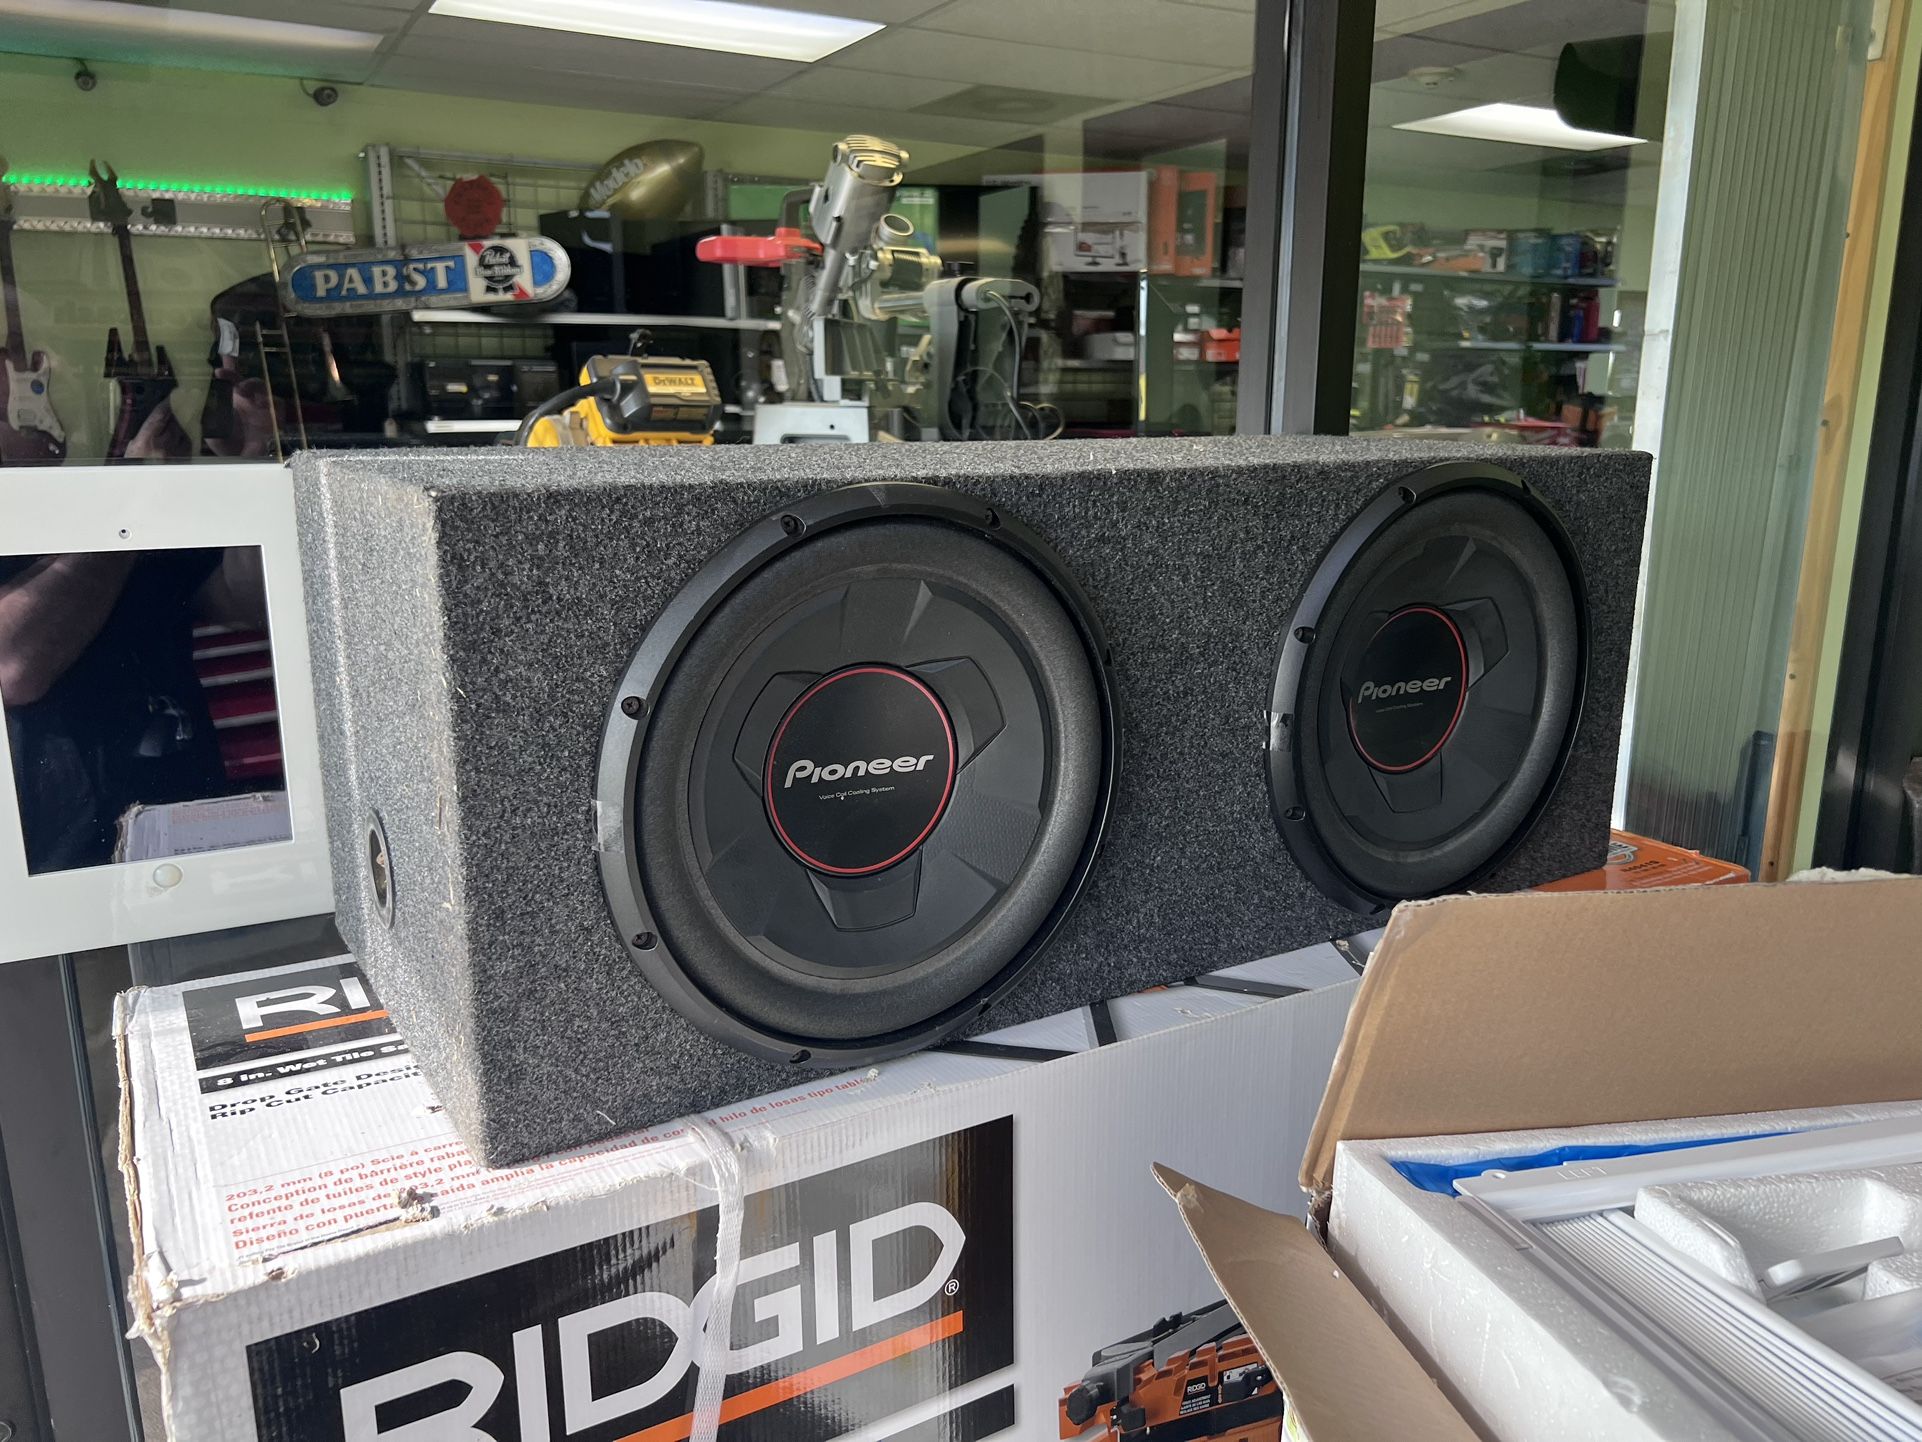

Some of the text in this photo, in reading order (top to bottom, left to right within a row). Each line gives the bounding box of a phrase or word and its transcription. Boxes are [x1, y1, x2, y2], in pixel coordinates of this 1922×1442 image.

[314, 260, 455, 298] PABST
[1358, 677, 1452, 704] Pioneer
[784, 755, 935, 789] Pioneer
[216, 1044, 410, 1087] 8 in. Wet Tile Sa
[209, 1093, 276, 1113] Drop
[285, 1078, 347, 1096] Gate
[210, 1070, 423, 1120] Rip Cut Capacit
[225, 1184, 275, 1202] 203,2
[281, 1175, 313, 1189] mm
[339, 1162, 366, 1176] po)
[370, 1154, 405, 1166] Scie
[424, 1140, 464, 1153] carre
[235, 1227, 299, 1250] Diseño
[305, 1217, 338, 1232] con
[539, 1162, 555, 1171] la
[559, 1139, 638, 1166] capacidad
[641, 1134, 659, 1145] de
[719, 1109, 747, 1124] hilo
[750, 1105, 768, 1115] de
[769, 1095, 806, 1109] losas
[807, 1087, 834, 1100] tipo
[227, 1182, 328, 1213] Conception
[333, 1176, 354, 1187] de
[230, 1203, 294, 1225] refente
[300, 1197, 321, 1208] de
[325, 1183, 375, 1201] tuiles
[379, 1177, 399, 1187] de
[404, 1166, 444, 1180] style
[448, 1159, 473, 1172] pla
[232, 1219, 288, 1238] Sierra
[293, 1211, 315, 1222] de
[320, 1199, 366, 1215] losas
[372, 1191, 392, 1203] de
[339, 1202, 967, 1442] RIDGID
